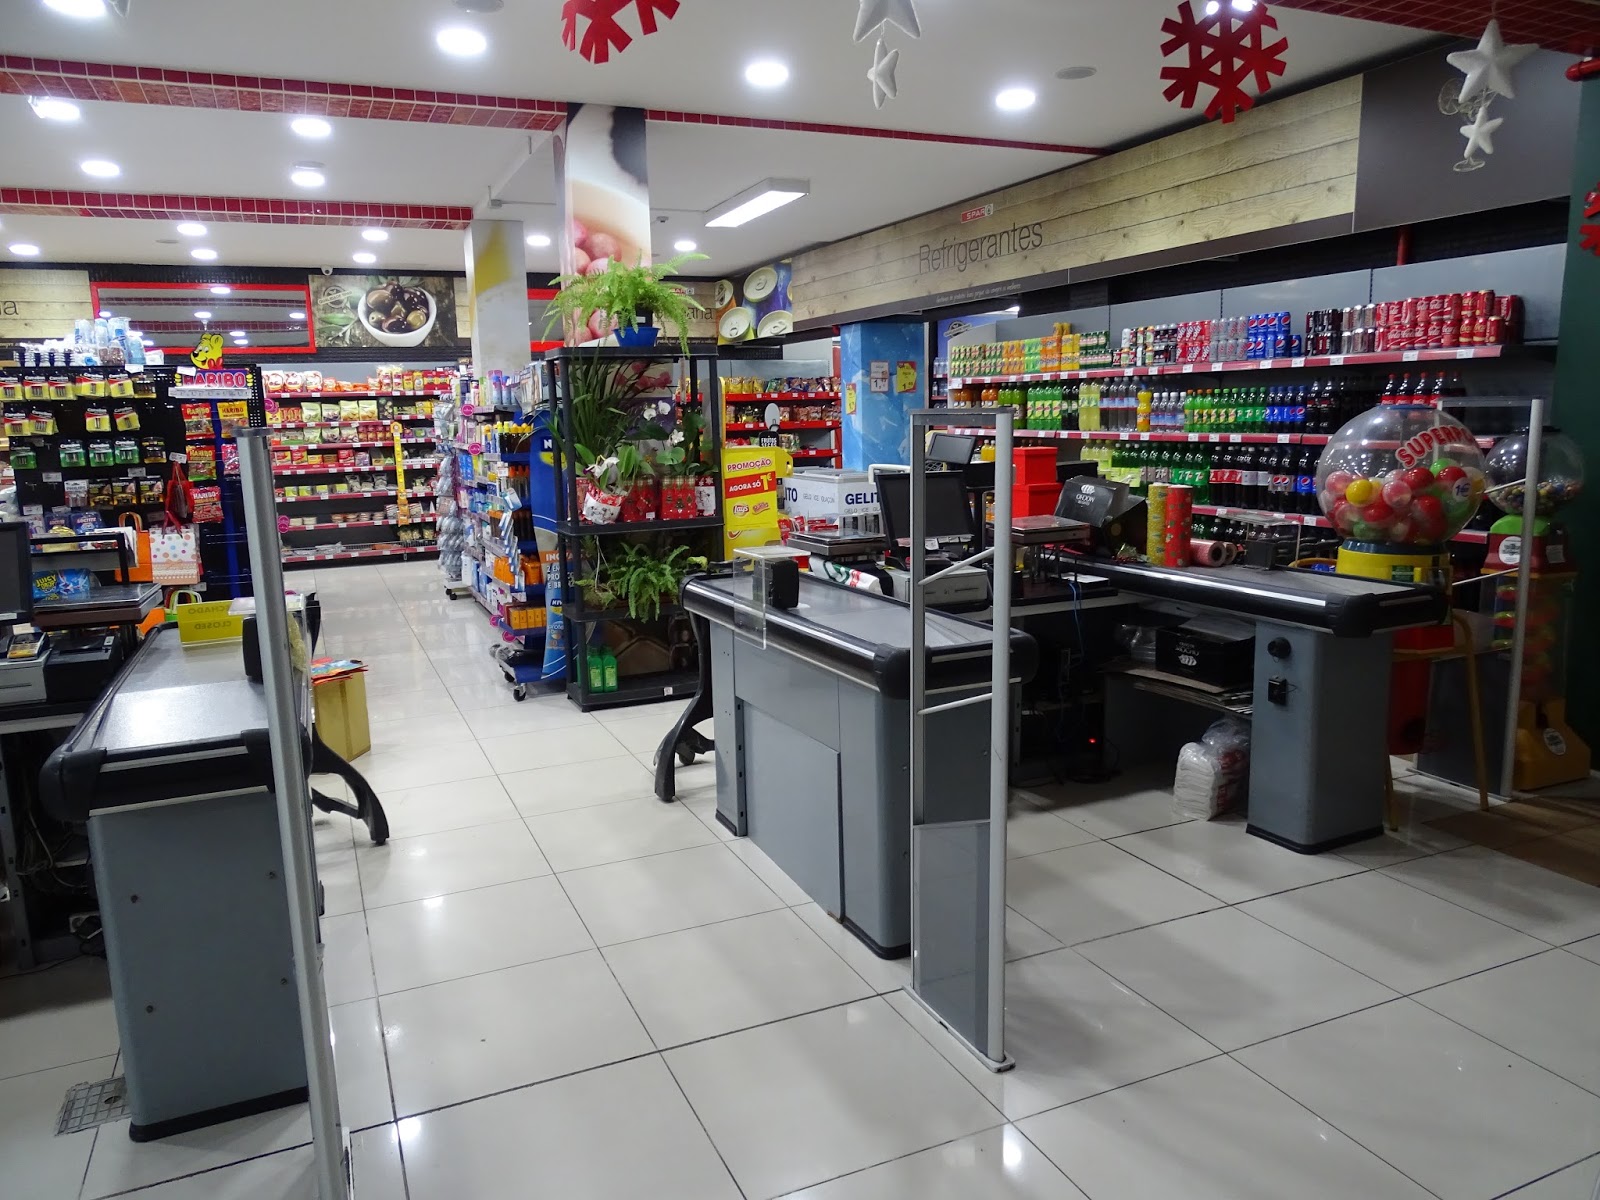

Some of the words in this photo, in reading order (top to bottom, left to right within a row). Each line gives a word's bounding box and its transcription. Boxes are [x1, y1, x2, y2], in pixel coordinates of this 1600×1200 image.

[966, 208, 986, 220] SPAR
[919, 222, 1043, 274] Refrigerantes
[182, 371, 246, 388] HARIBO
[727, 458, 772, 472] PROMOÇÃO
[729, 482, 752, 492] AGORA
[752, 479, 761, 488] SÓ
[760, 472, 773, 491] 1€
[784, 487, 798, 502] ITO
[1455, 482, 1471, 498] 1€
[845, 492, 881, 505] GELIT
